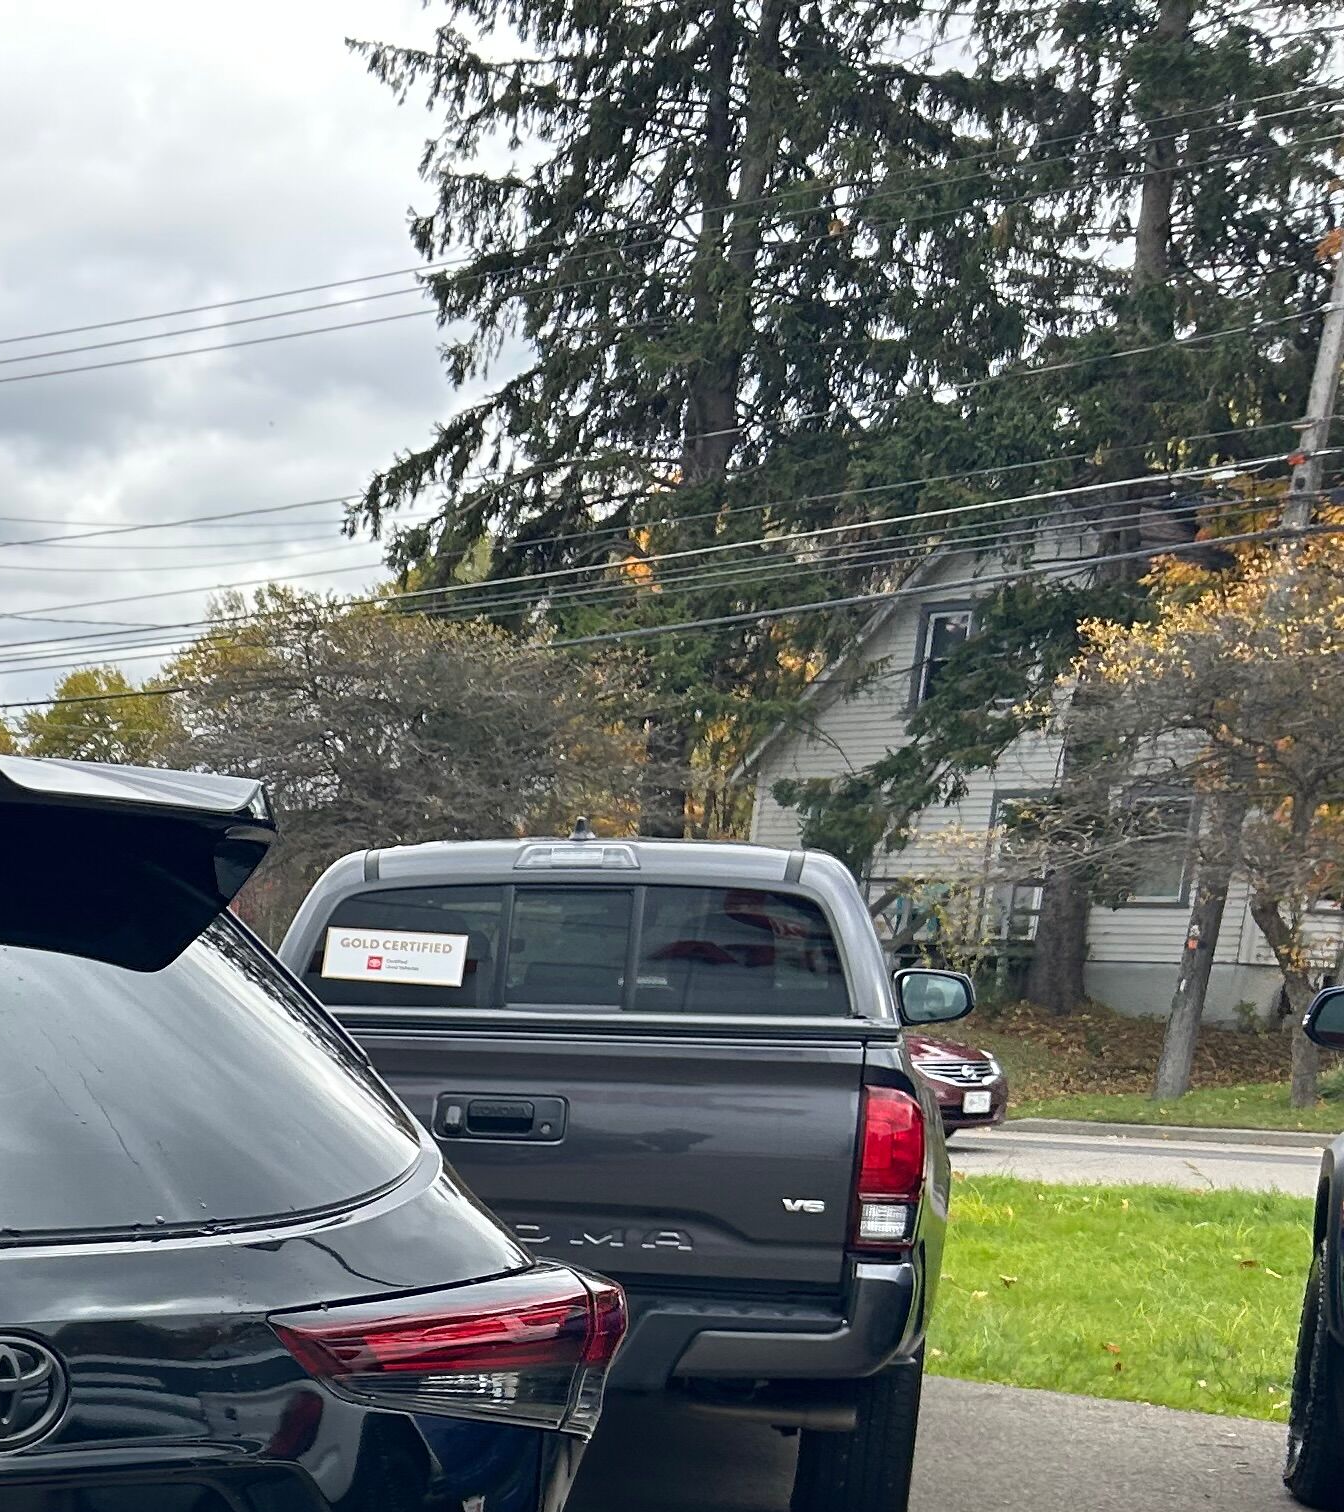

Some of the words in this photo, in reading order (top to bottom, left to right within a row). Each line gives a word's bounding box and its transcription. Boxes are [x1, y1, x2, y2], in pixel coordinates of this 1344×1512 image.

[340, 937, 380, 949] GOLD
[382, 940, 453, 954] CERTIFIED
[782, 1198, 825, 1213] V6
[512, 1222, 693, 1250] OMA
